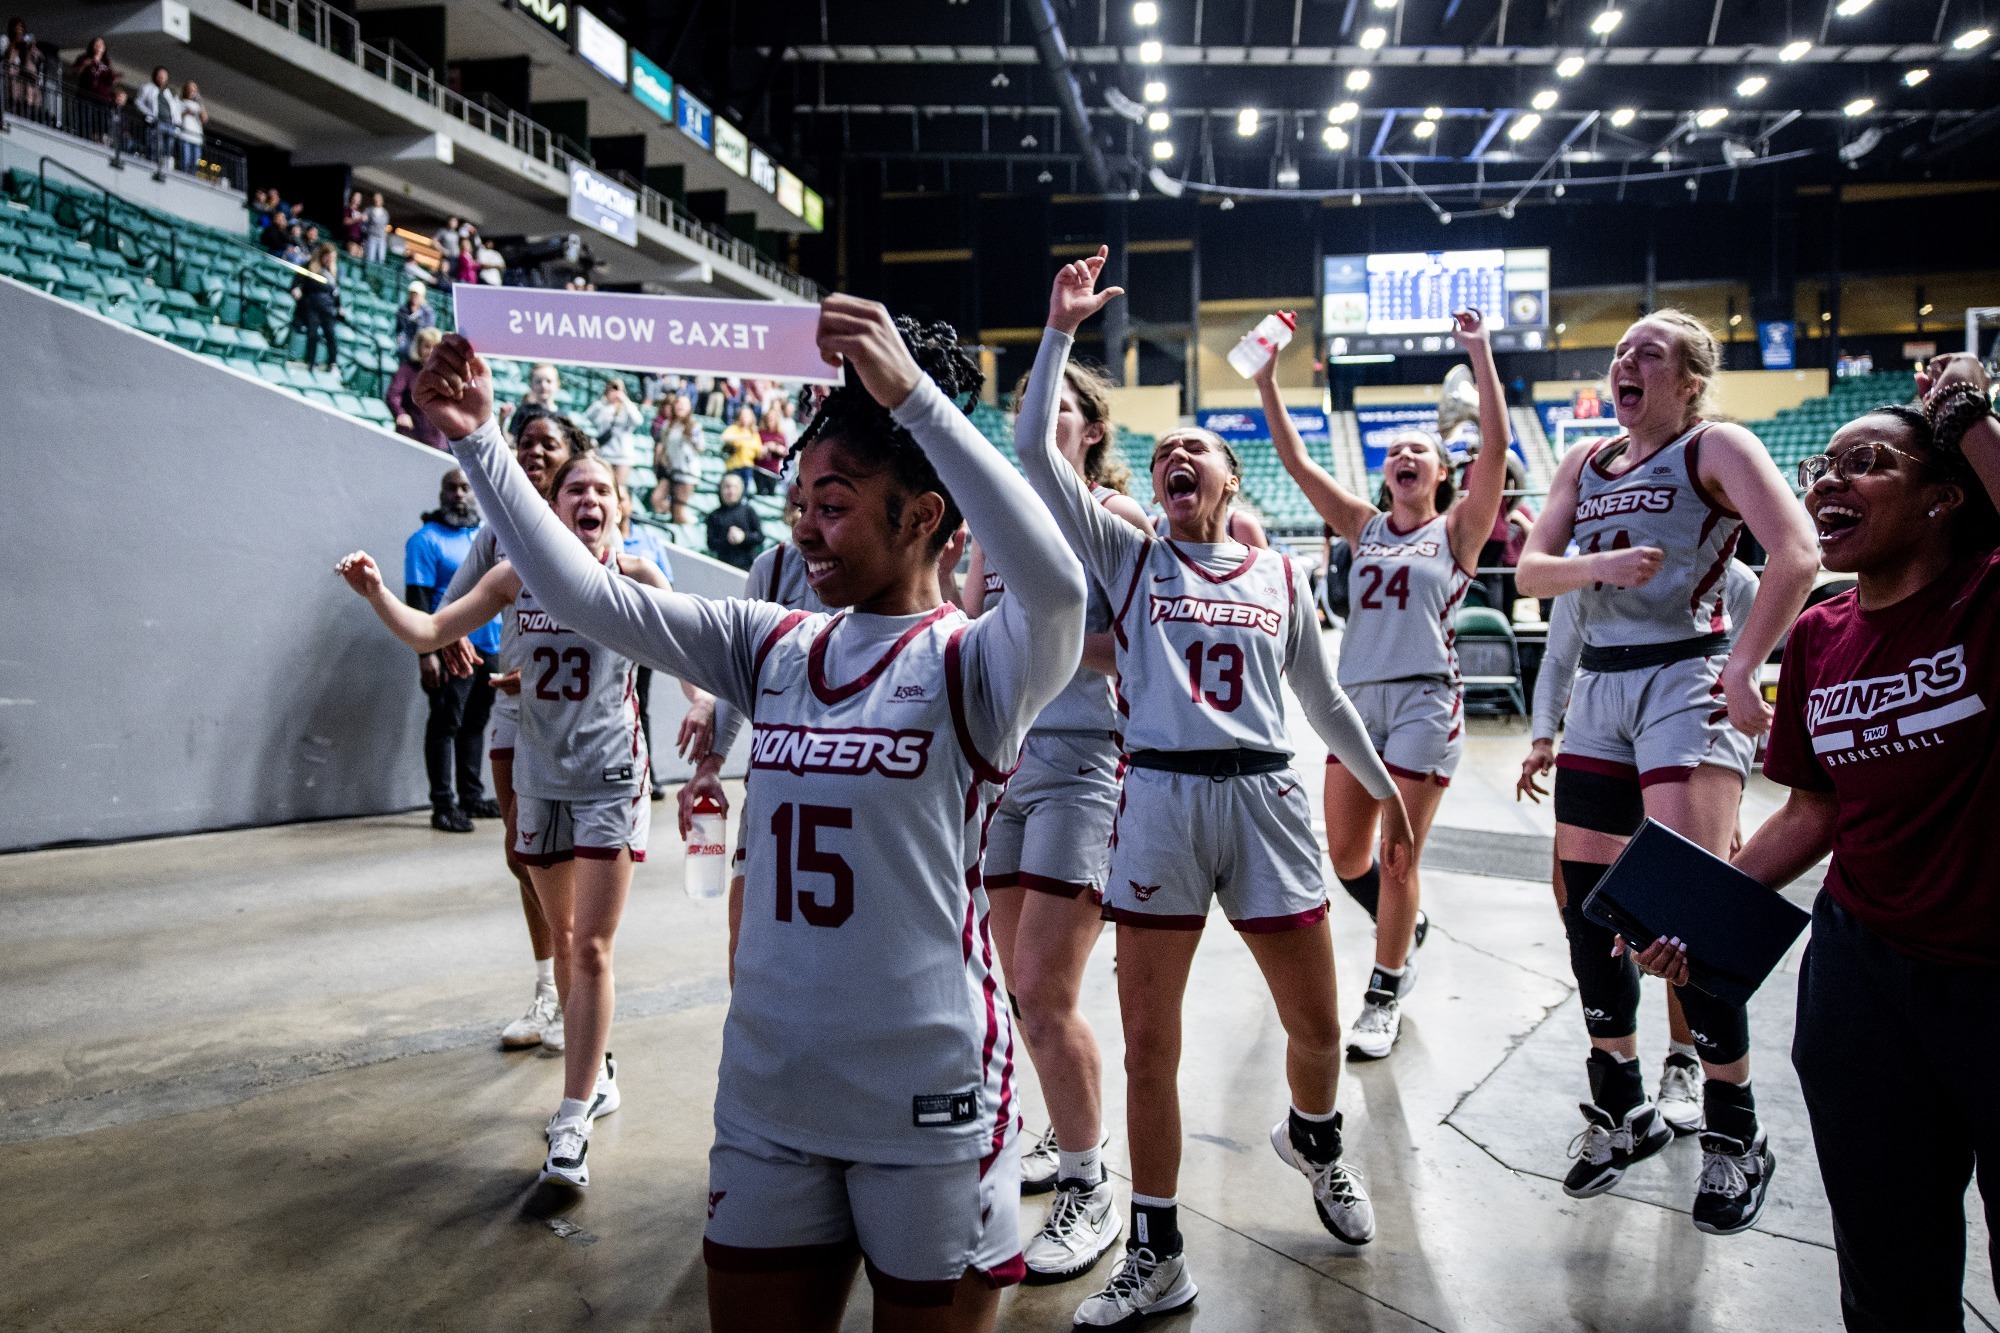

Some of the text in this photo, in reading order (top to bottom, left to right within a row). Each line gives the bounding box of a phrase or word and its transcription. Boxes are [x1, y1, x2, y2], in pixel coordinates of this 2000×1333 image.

[1574, 487, 1674, 523] IONEERS
[1359, 565, 1410, 611] 24
[517, 611, 560, 634] PION
[1151, 596, 1281, 636] PIONEERS
[533, 647, 591, 702] 23
[1185, 641, 1245, 713] 13
[1808, 646, 1966, 735] PIONEERS
[1827, 733, 1944, 767] BASKETBALL
[1863, 725, 1888, 742] TWU
[771, 802, 855, 928] 15
[958, 1101, 969, 1116] M
